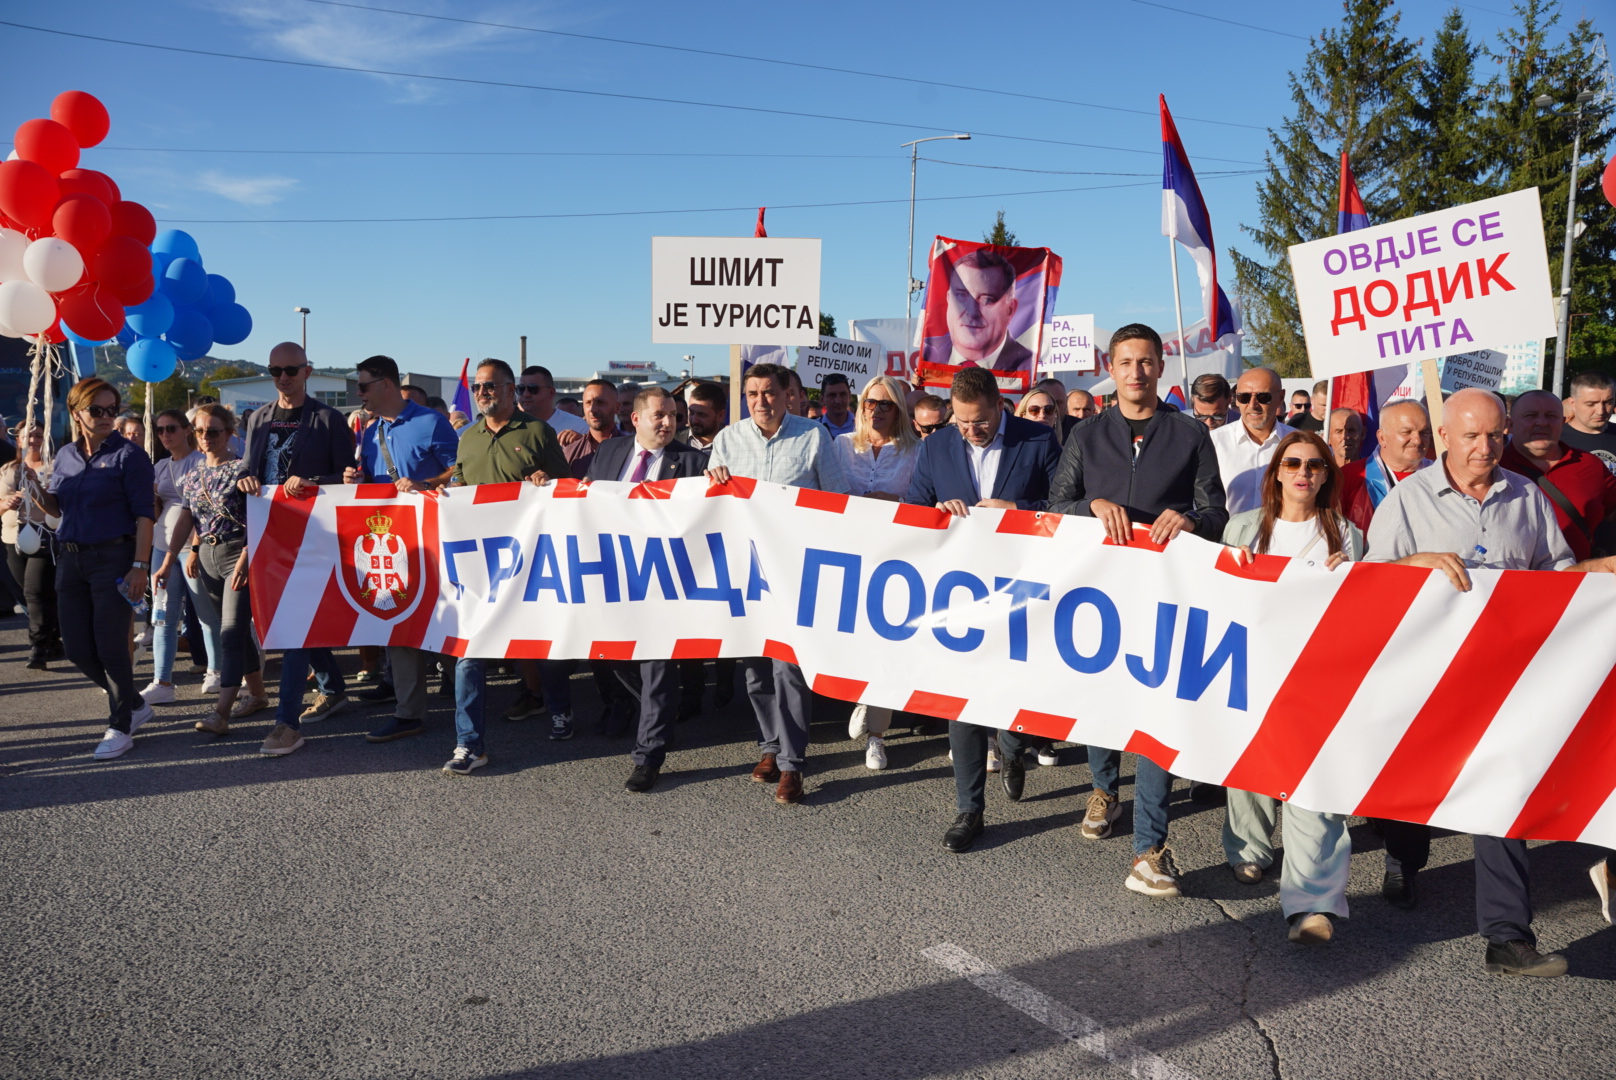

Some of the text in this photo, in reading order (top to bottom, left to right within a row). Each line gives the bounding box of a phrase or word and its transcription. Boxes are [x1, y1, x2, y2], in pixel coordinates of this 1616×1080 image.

[1323, 211, 1504, 276] ОВДЈЕ СЕ
[690, 257, 784, 287] ШМИТ
[1330, 252, 1516, 336] ДОДИК
[658, 303, 814, 329] ЈЕ ТУРИСТА
[831, 342, 855, 356] СМО
[856, 345, 872, 359] МИ
[1376, 318, 1475, 359] ПИТА
[807, 355, 868, 375] РЕПУБЛИКА
[1446, 365, 1453, 375] У
[1453, 368, 1498, 388] РЕПУБЛИКУ
[1472, 361, 1503, 377] ДОШЛИ
[796, 547, 1248, 712] ПОСТОЈИ
